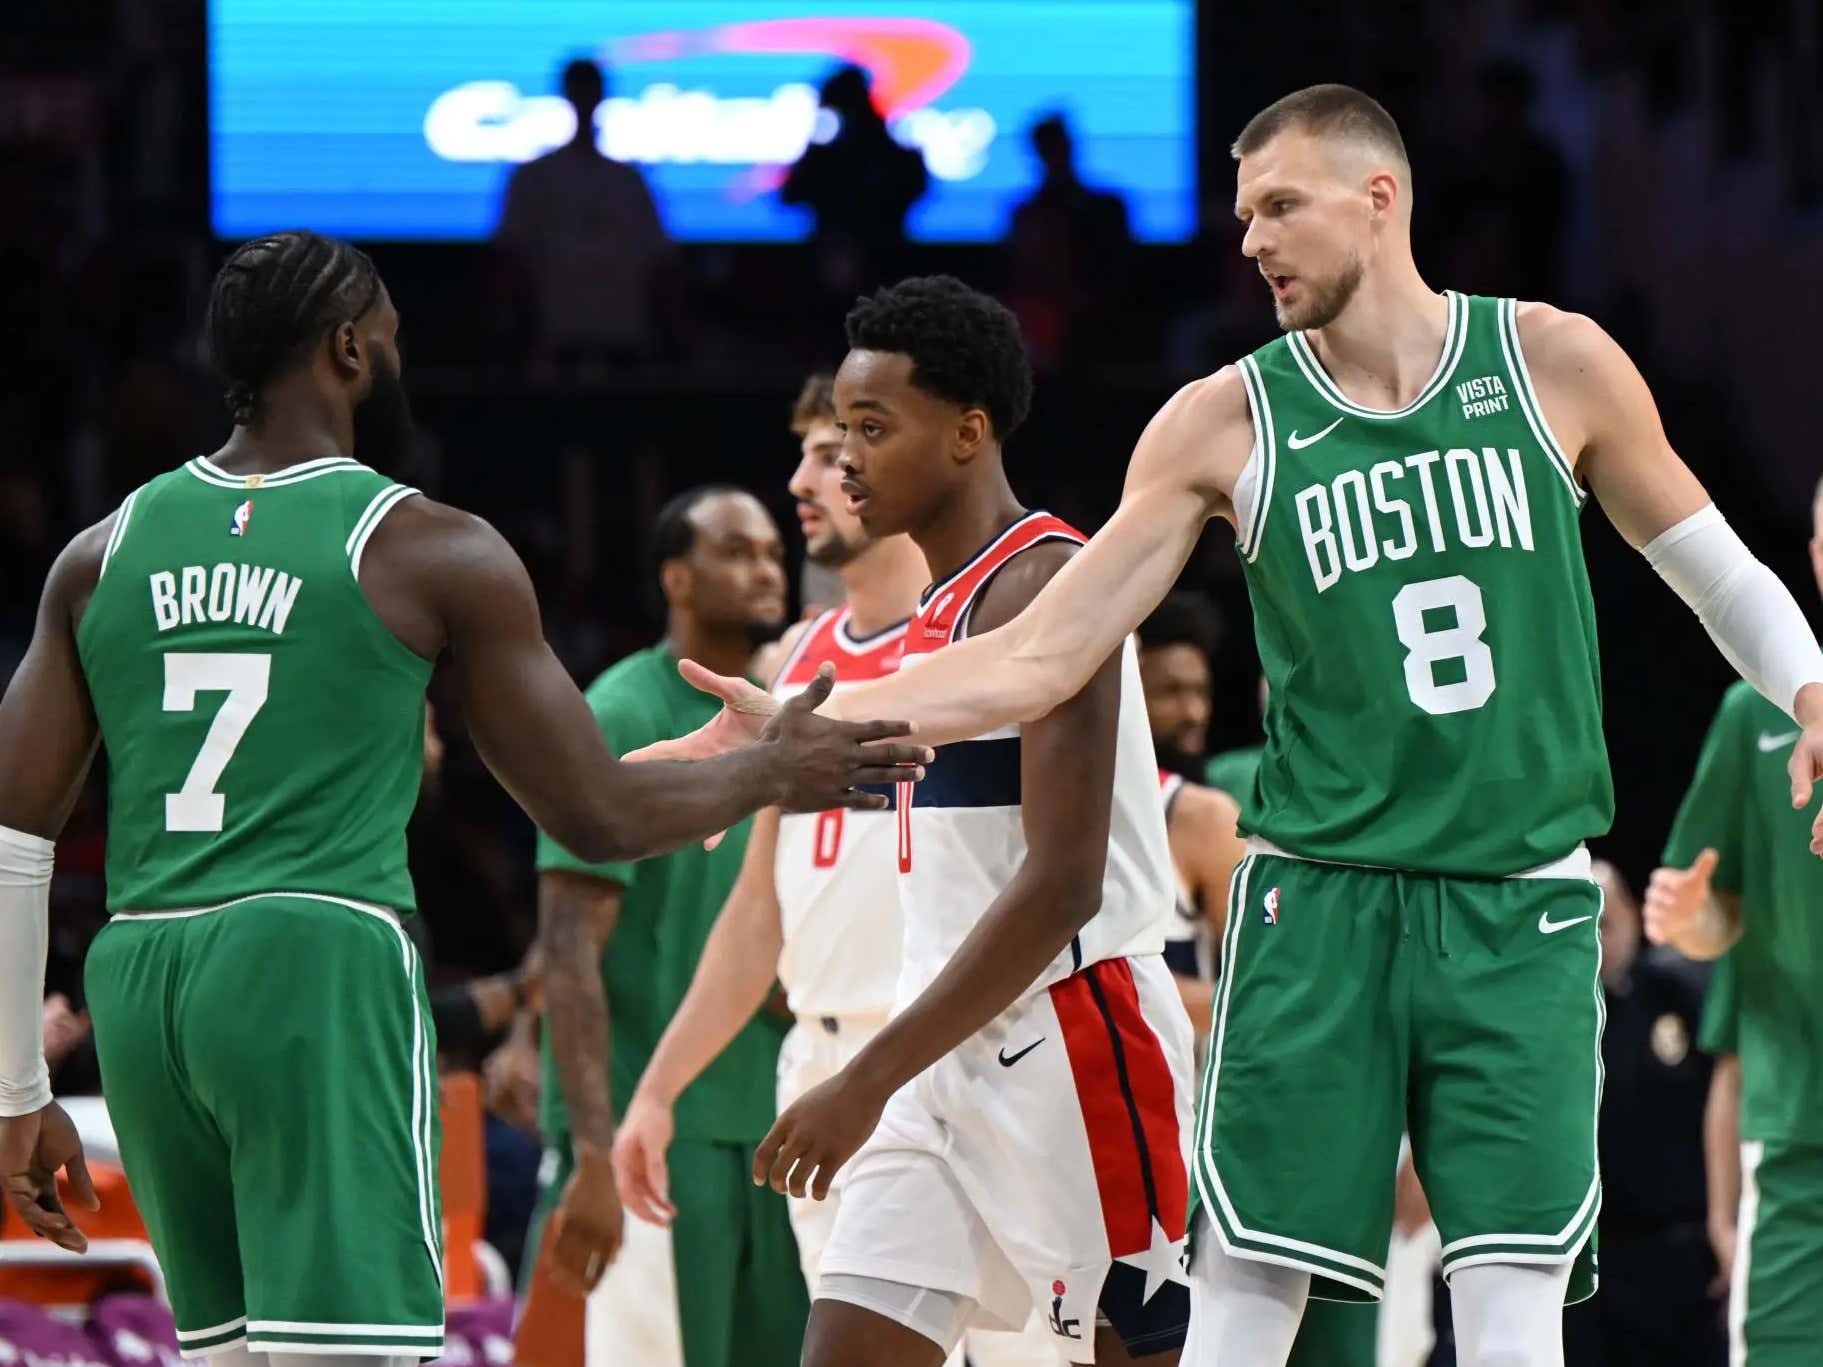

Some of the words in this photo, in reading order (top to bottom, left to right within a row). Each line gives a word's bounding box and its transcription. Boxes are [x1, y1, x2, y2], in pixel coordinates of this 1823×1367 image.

[1456, 375, 1507, 404] VISTA
[1462, 394, 1509, 420] PRINT
[1294, 447, 1535, 594] BOSTON
[149, 562, 303, 635] BROWN
[1391, 574, 1497, 715] 8
[161, 652, 272, 832] 7
